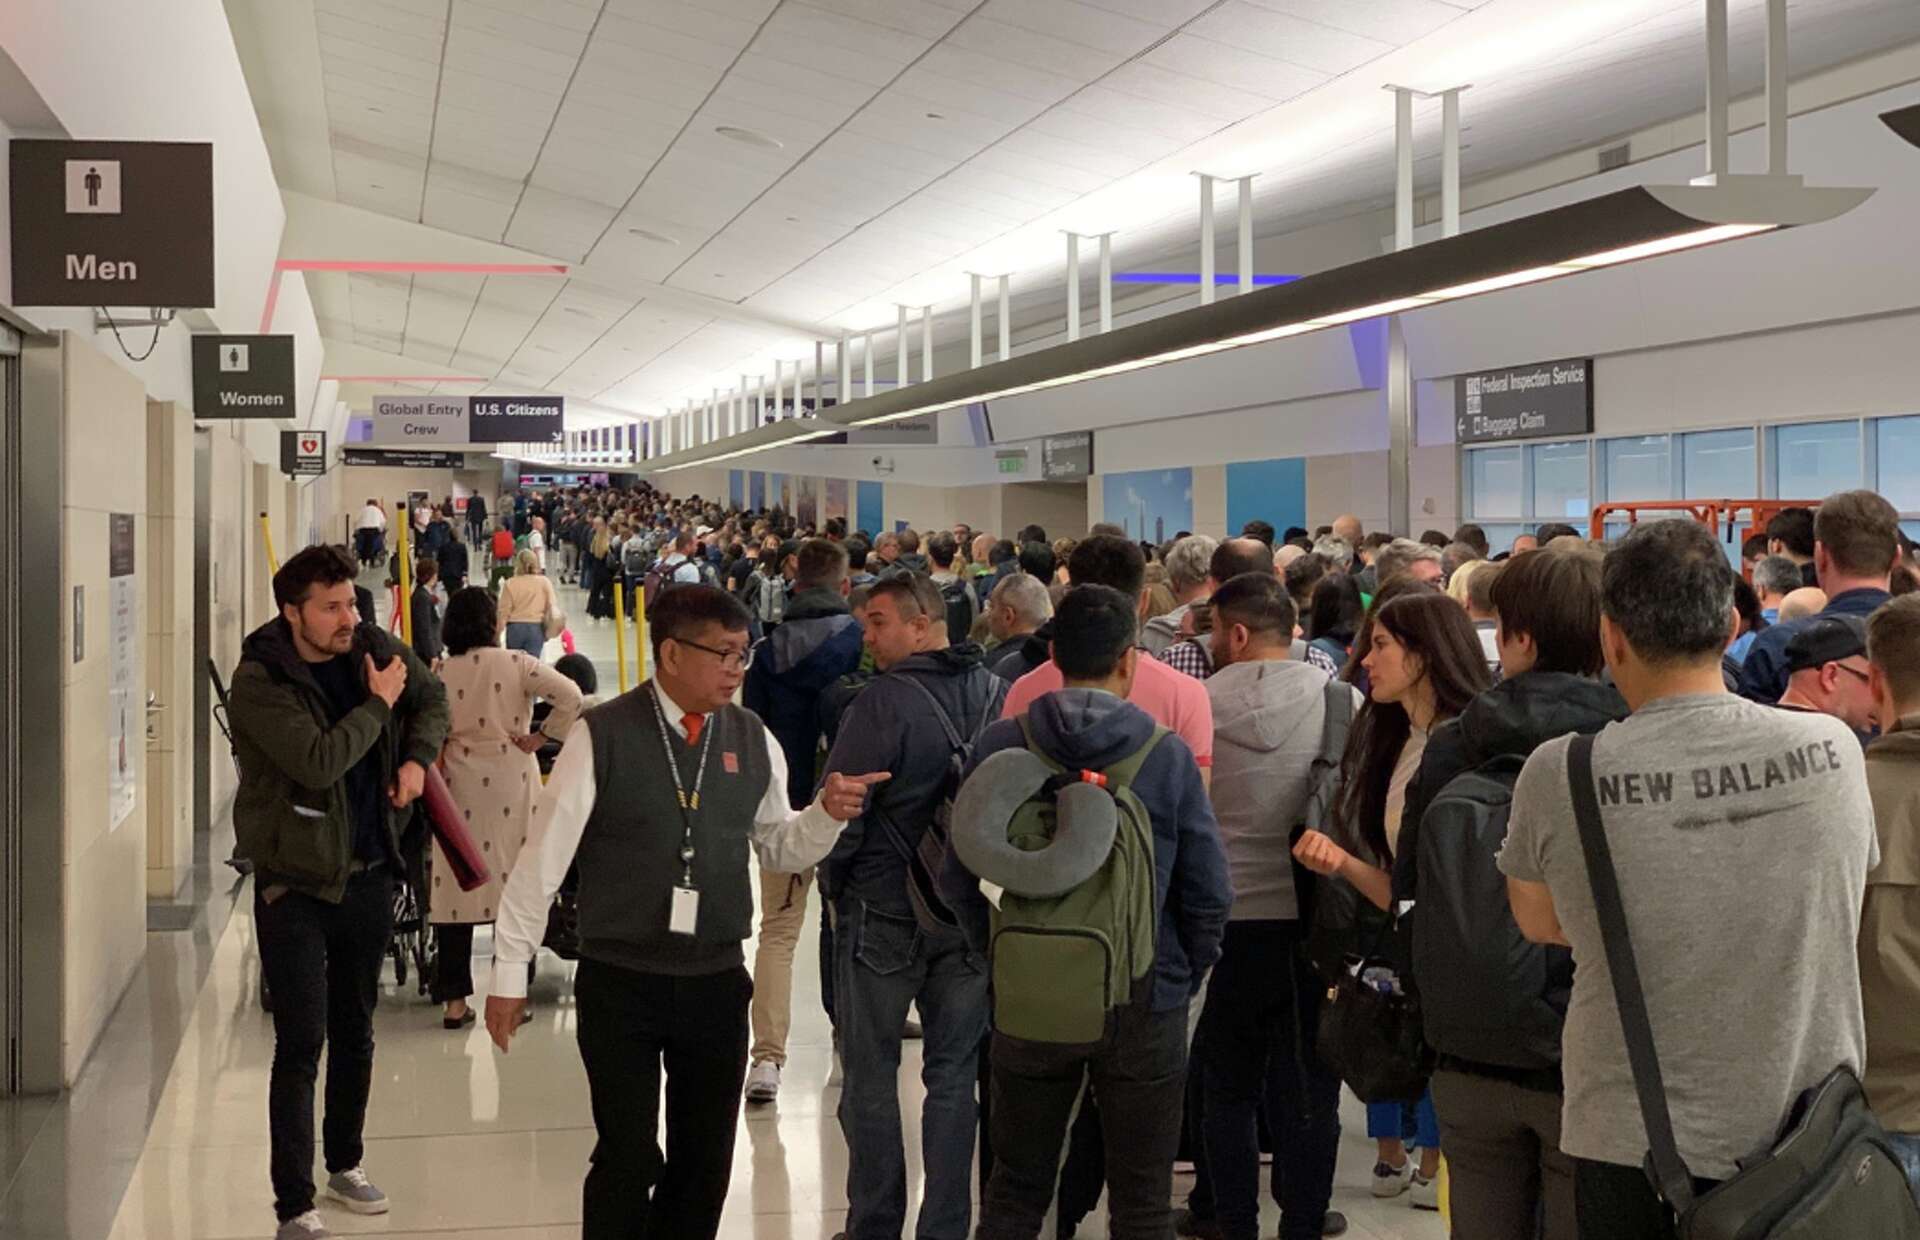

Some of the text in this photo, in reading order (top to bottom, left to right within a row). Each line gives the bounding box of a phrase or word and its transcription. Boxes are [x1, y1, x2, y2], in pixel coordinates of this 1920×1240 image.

[65, 254, 137, 280] Men
[1481, 366, 1584, 393] Federal Inspection Service
[219, 391, 284, 406] Women
[379, 403, 463, 417] Global Entry
[475, 403, 559, 416] U.S. Citizens
[403, 422, 440, 435] Crew
[1599, 740, 1840, 806] NEW BALANCE
